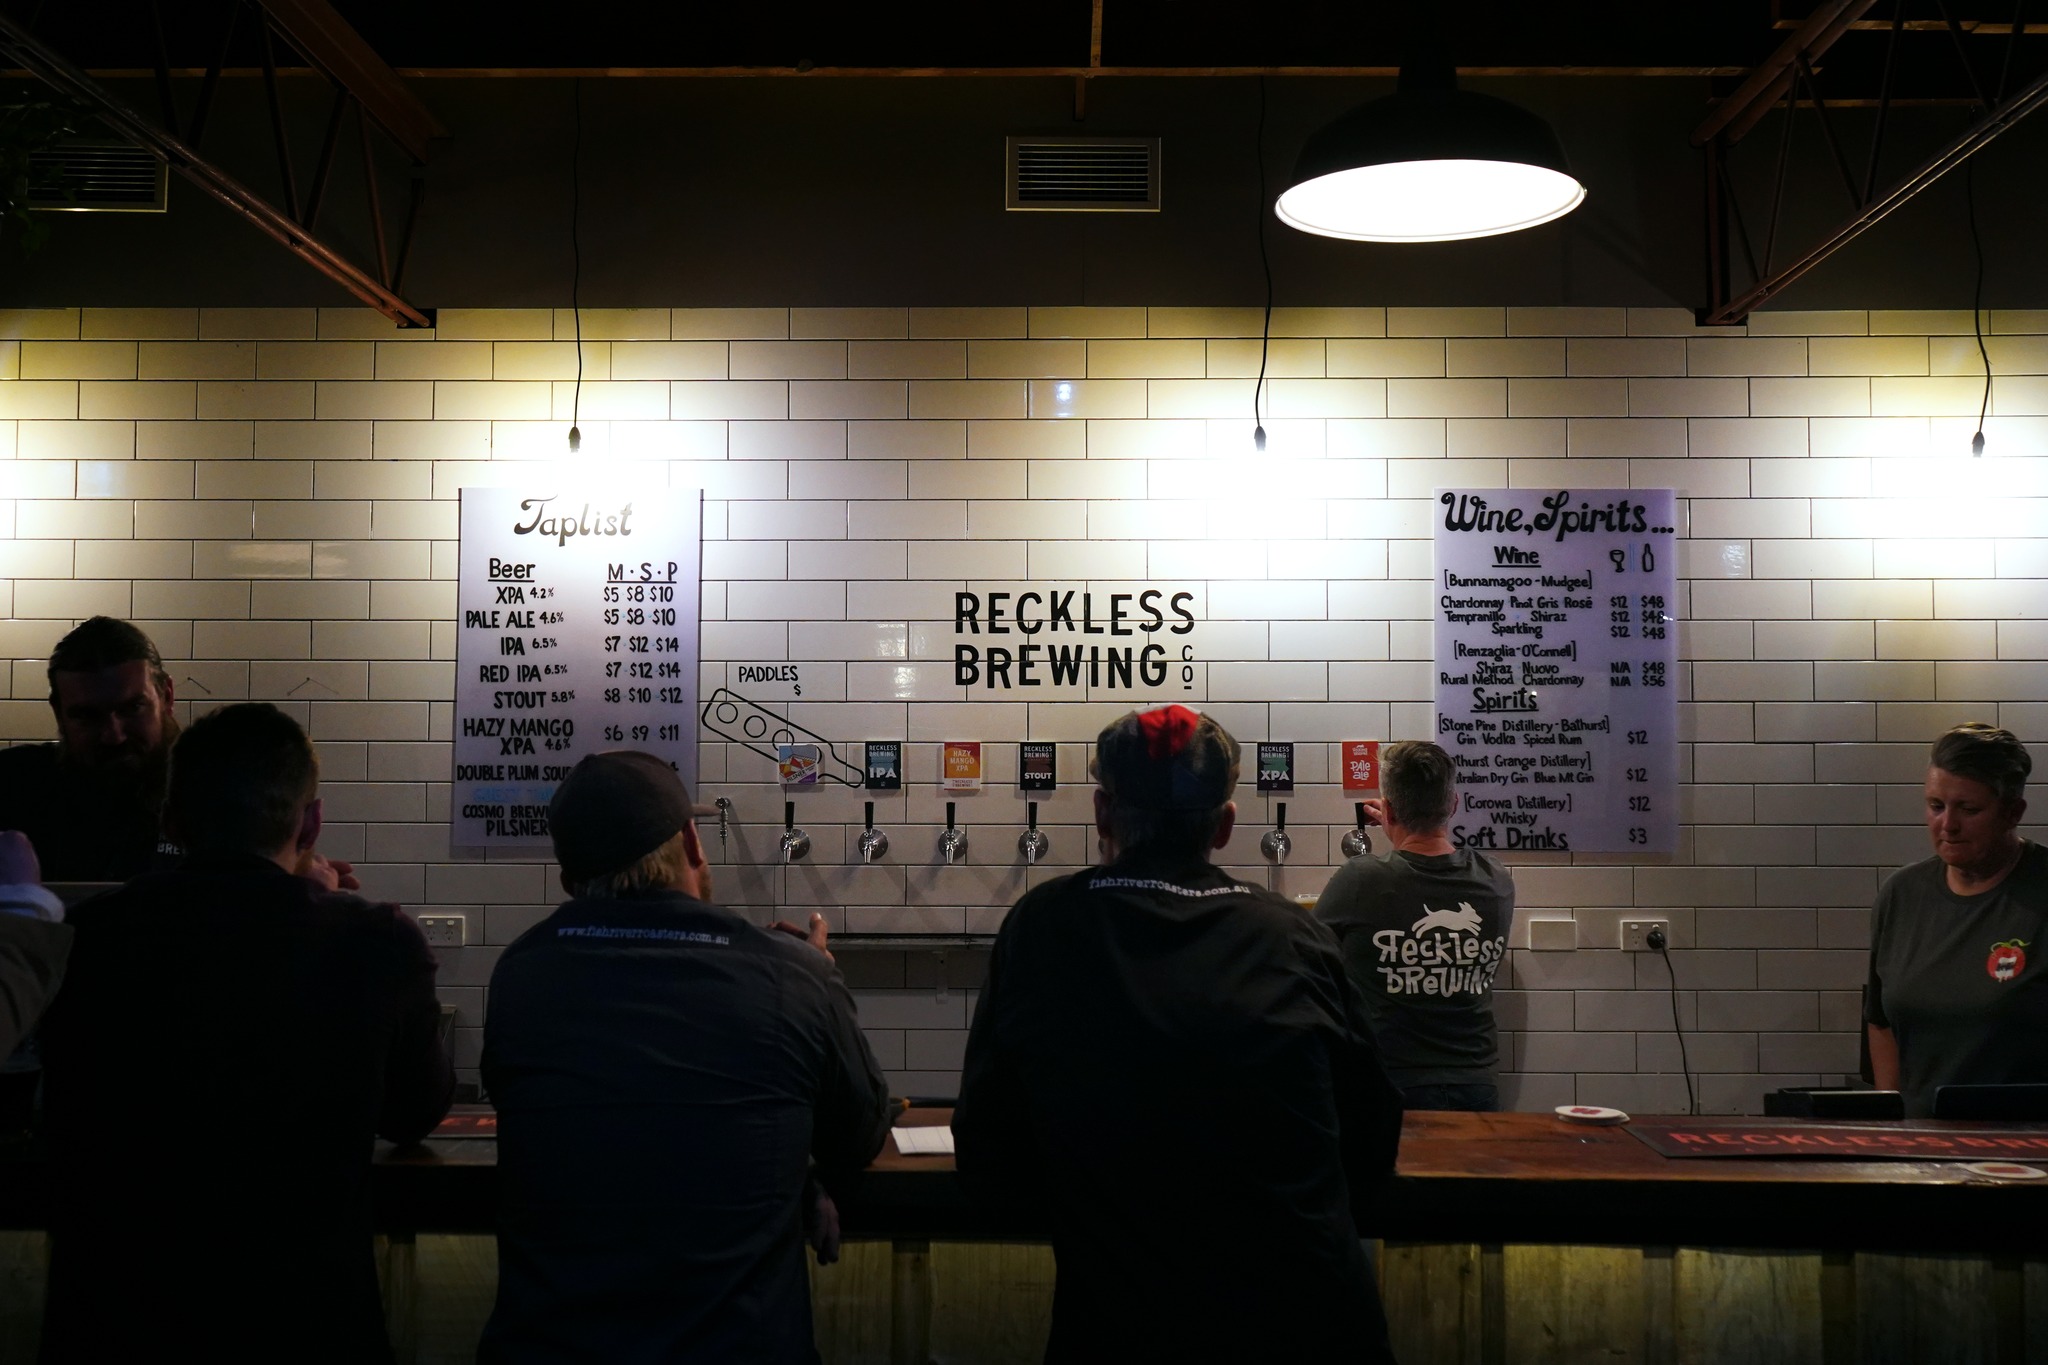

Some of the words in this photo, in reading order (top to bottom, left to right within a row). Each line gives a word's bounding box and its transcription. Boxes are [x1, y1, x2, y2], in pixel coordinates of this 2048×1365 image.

[514, 494, 632, 547] Taplist
[1494, 546, 1539, 564] Wine
[490, 558, 536, 578] Beer
[496, 587, 524, 604] XPA
[530, 587, 554, 599] 4.2%
[604, 586, 619, 602] $5
[627, 586, 644, 602] $8
[650, 586, 673, 602] $10
[1441, 596, 1504, 611] Chardonnay
[1510, 597, 1533, 608] Pinot
[1537, 597, 1559, 608] Gris
[1610, 596, 1628, 609] $12
[1641, 596, 1664, 609] $48
[466, 611, 500, 628] PALE
[506, 611, 535, 628] ALE
[539, 611, 564, 624] 4.6%
[604, 608, 619, 625] $5
[627, 608, 645, 625] $8
[652, 608, 675, 626] $10
[955, 590, 1194, 636] RECKLESS
[1445, 611, 1506, 625] Tempranillo
[1531, 611, 1566, 622] Shiraz
[1611, 611, 1630, 623] $12
[1642, 611, 1664, 623] $48
[1492, 623, 1543, 639] Sparkling
[1611, 625, 1630, 638] $12
[1643, 626, 1665, 639] $48
[501, 637, 524, 655] IPA
[532, 638, 557, 648] 6.5%
[605, 636, 620, 652] $7
[629, 637, 648, 652] $12
[656, 637, 678, 653] $14
[480, 665, 509, 682] RED
[517, 665, 541, 682] IPA
[544, 664, 567, 674] 6.5%
[606, 661, 622, 678] $7
[630, 662, 652, 678] $12
[659, 662, 680, 678] $14
[738, 665, 799, 683] PADDLES
[955, 644, 1167, 688] BREWING
[1477, 661, 1512, 675] Shiraz
[1523, 663, 1559, 674] Nuovo
[1611, 663, 1631, 674] N/A
[1643, 663, 1665, 675] $48
[1441, 672, 1468, 685] Rural
[1473, 673, 1513, 685] Method
[1523, 675, 1584, 687] Chardonnay
[1611, 676, 1631, 687] N/A
[1642, 675, 1665, 687] $56
[493, 691, 546, 709] STOUT
[551, 690, 575, 703] 5.8%
[604, 688, 620, 703] $8
[629, 688, 651, 703] $10
[660, 687, 683, 704] $12
[1473, 687, 1537, 713] Spirits
[463, 718, 505, 736] HAZY
[510, 719, 573, 736] MANGO
[605, 725, 623, 741] $6
[632, 725, 648, 741] $9
[659, 726, 679, 741] $11
[1476, 720, 1496, 731] Pine
[500, 737, 535, 755] XPA
[545, 738, 570, 750] 4.6%
[1457, 735, 1476, 745] Gin
[1482, 735, 1515, 745] Vodka
[1524, 734, 1555, 747] Spiced
[1559, 735, 1582, 744] Rum
[1628, 731, 1648, 745] $12
[1495, 755, 1536, 771] Grange
[457, 765, 504, 781] DOUBLE
[508, 766, 538, 780] PLUM
[870, 768, 897, 778] IPA
[1261, 770, 1290, 780] XPA
[1491, 774, 1508, 786] Dry
[1511, 773, 1528, 783] Gin
[1534, 773, 1556, 783] Blue
[1559, 773, 1575, 783] Mt
[1577, 773, 1594, 783] Gin
[1627, 768, 1648, 782] $12
[463, 805, 504, 818] COSMO
[1629, 796, 1651, 811] $12
[486, 819, 549, 836] PILSNER
[1491, 812, 1537, 827] Whisky
[1452, 826, 1496, 848] Soft
[1507, 827, 1568, 849] Drinks
[1628, 829, 1647, 844] $3
[1088, 877, 1251, 897] fishriverroasters.com.au
[557, 925, 730, 945] www.fishriverroasters.com.au
[1669, 1132, 1953, 1147] RECKLESS
